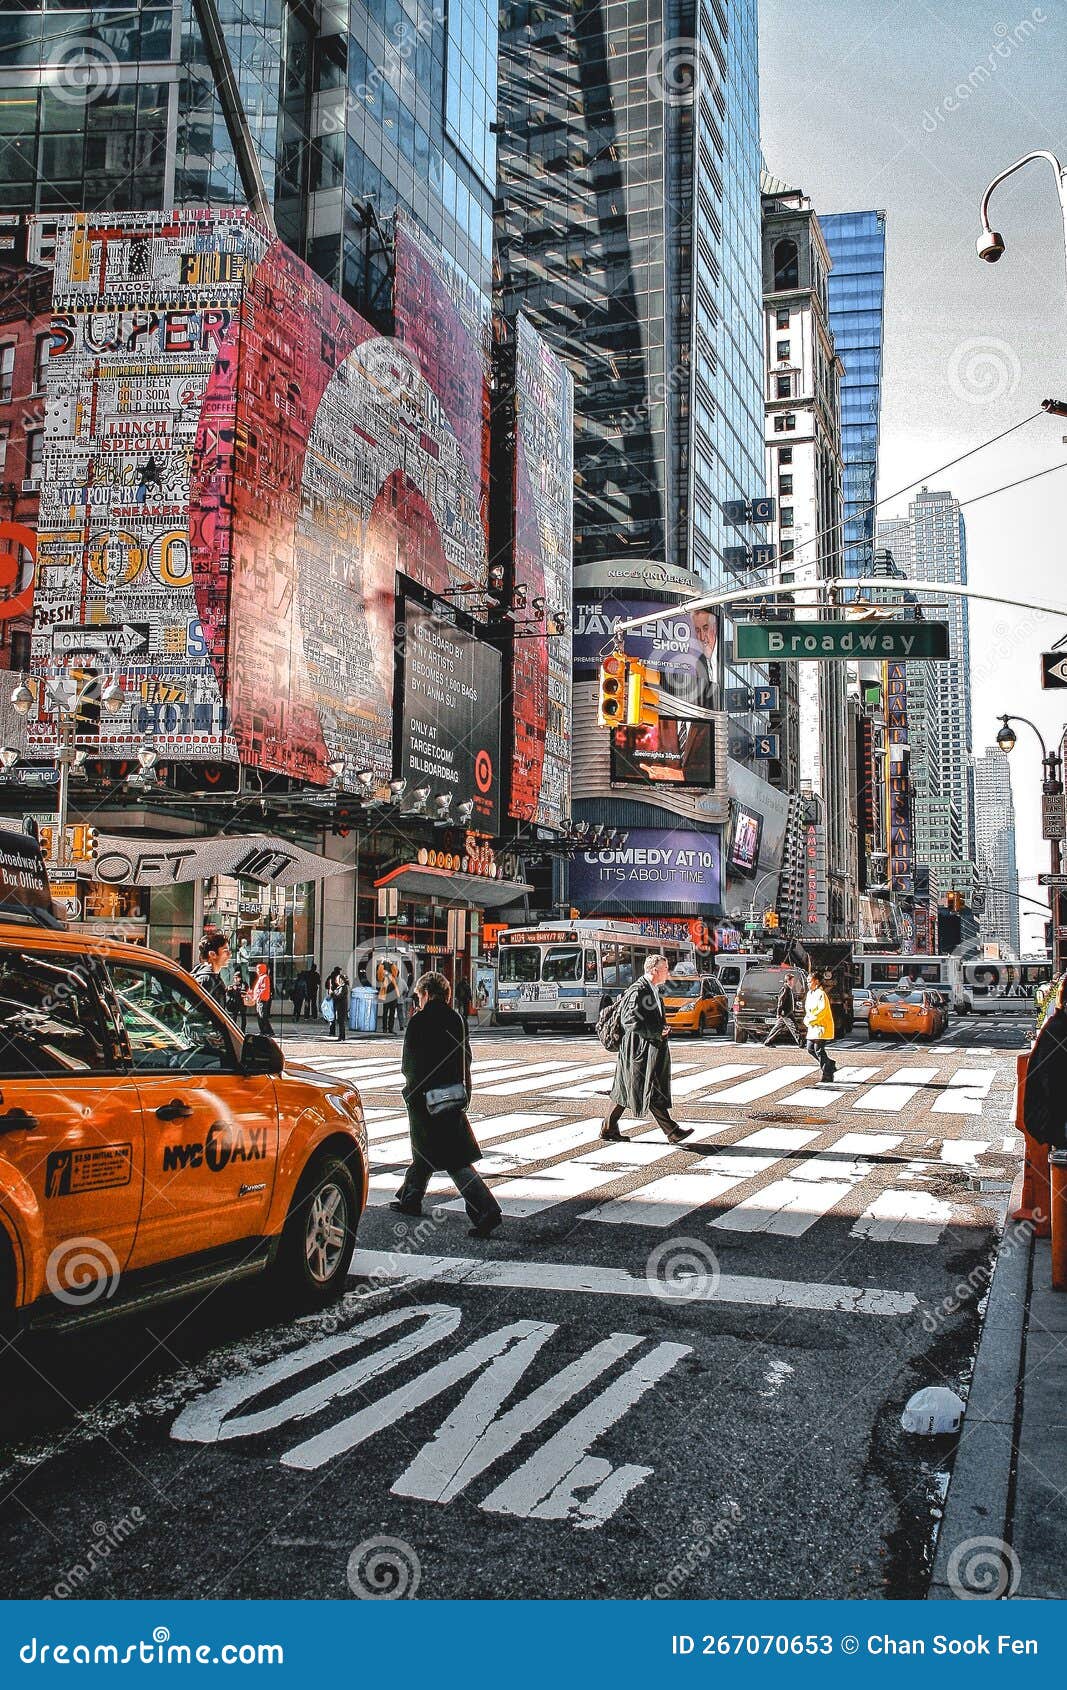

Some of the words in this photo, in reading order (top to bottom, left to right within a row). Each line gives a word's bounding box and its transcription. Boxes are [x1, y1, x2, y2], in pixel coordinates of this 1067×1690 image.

[109, 283, 151, 292] TACOS
[49, 310, 232, 357] SUPER
[117, 390, 143, 401] COLD
[146, 389, 170, 400] SODA
[206, 403, 236, 413] COFFEE
[108, 420, 168, 435] LUNCH
[101, 437, 174, 452] SPECIAL
[112, 505, 190, 517] SNEAKERS
[608, 570, 630, 578] NBC
[643, 574, 694, 587] UNIVERSAL
[33, 604, 74, 626] FRESH
[577, 605, 602, 615] THE
[574, 616, 621, 635] JAY
[627, 616, 691, 642] LENO
[62, 634, 92, 647] ONE
[105, 634, 136, 648] WAY
[419, 625, 454, 655] BILLBOARD
[455, 646, 464, 661] BY
[653, 638, 690, 653] SHOW
[768, 631, 916, 655] Broadway
[428, 648, 455, 673] ARTISTS
[411, 677, 421, 692] BY
[427, 685, 445, 704] ANNA
[412, 659, 444, 685] BECOMES
[461, 683, 479, 702] BAGS
[410, 718, 428, 737] ONLY
[428, 726, 438, 740] AT
[410, 736, 454, 763] TARGET.COM/
[409, 755, 460, 783] BILLBOARDBAG
[584, 848, 673, 865] COMEDY
[675, 851, 696, 867] AT
[698, 852, 714, 868] 10.
[2, 868, 20, 887] Box
[20, 871, 45, 890] Office
[599, 869, 627, 882] IT'S
[629, 869, 677, 883] ABOUT
[679, 870, 706, 884] TIME.
[163, 1142, 204, 1172] NYC
[205, 1120, 267, 1173] TAXI
